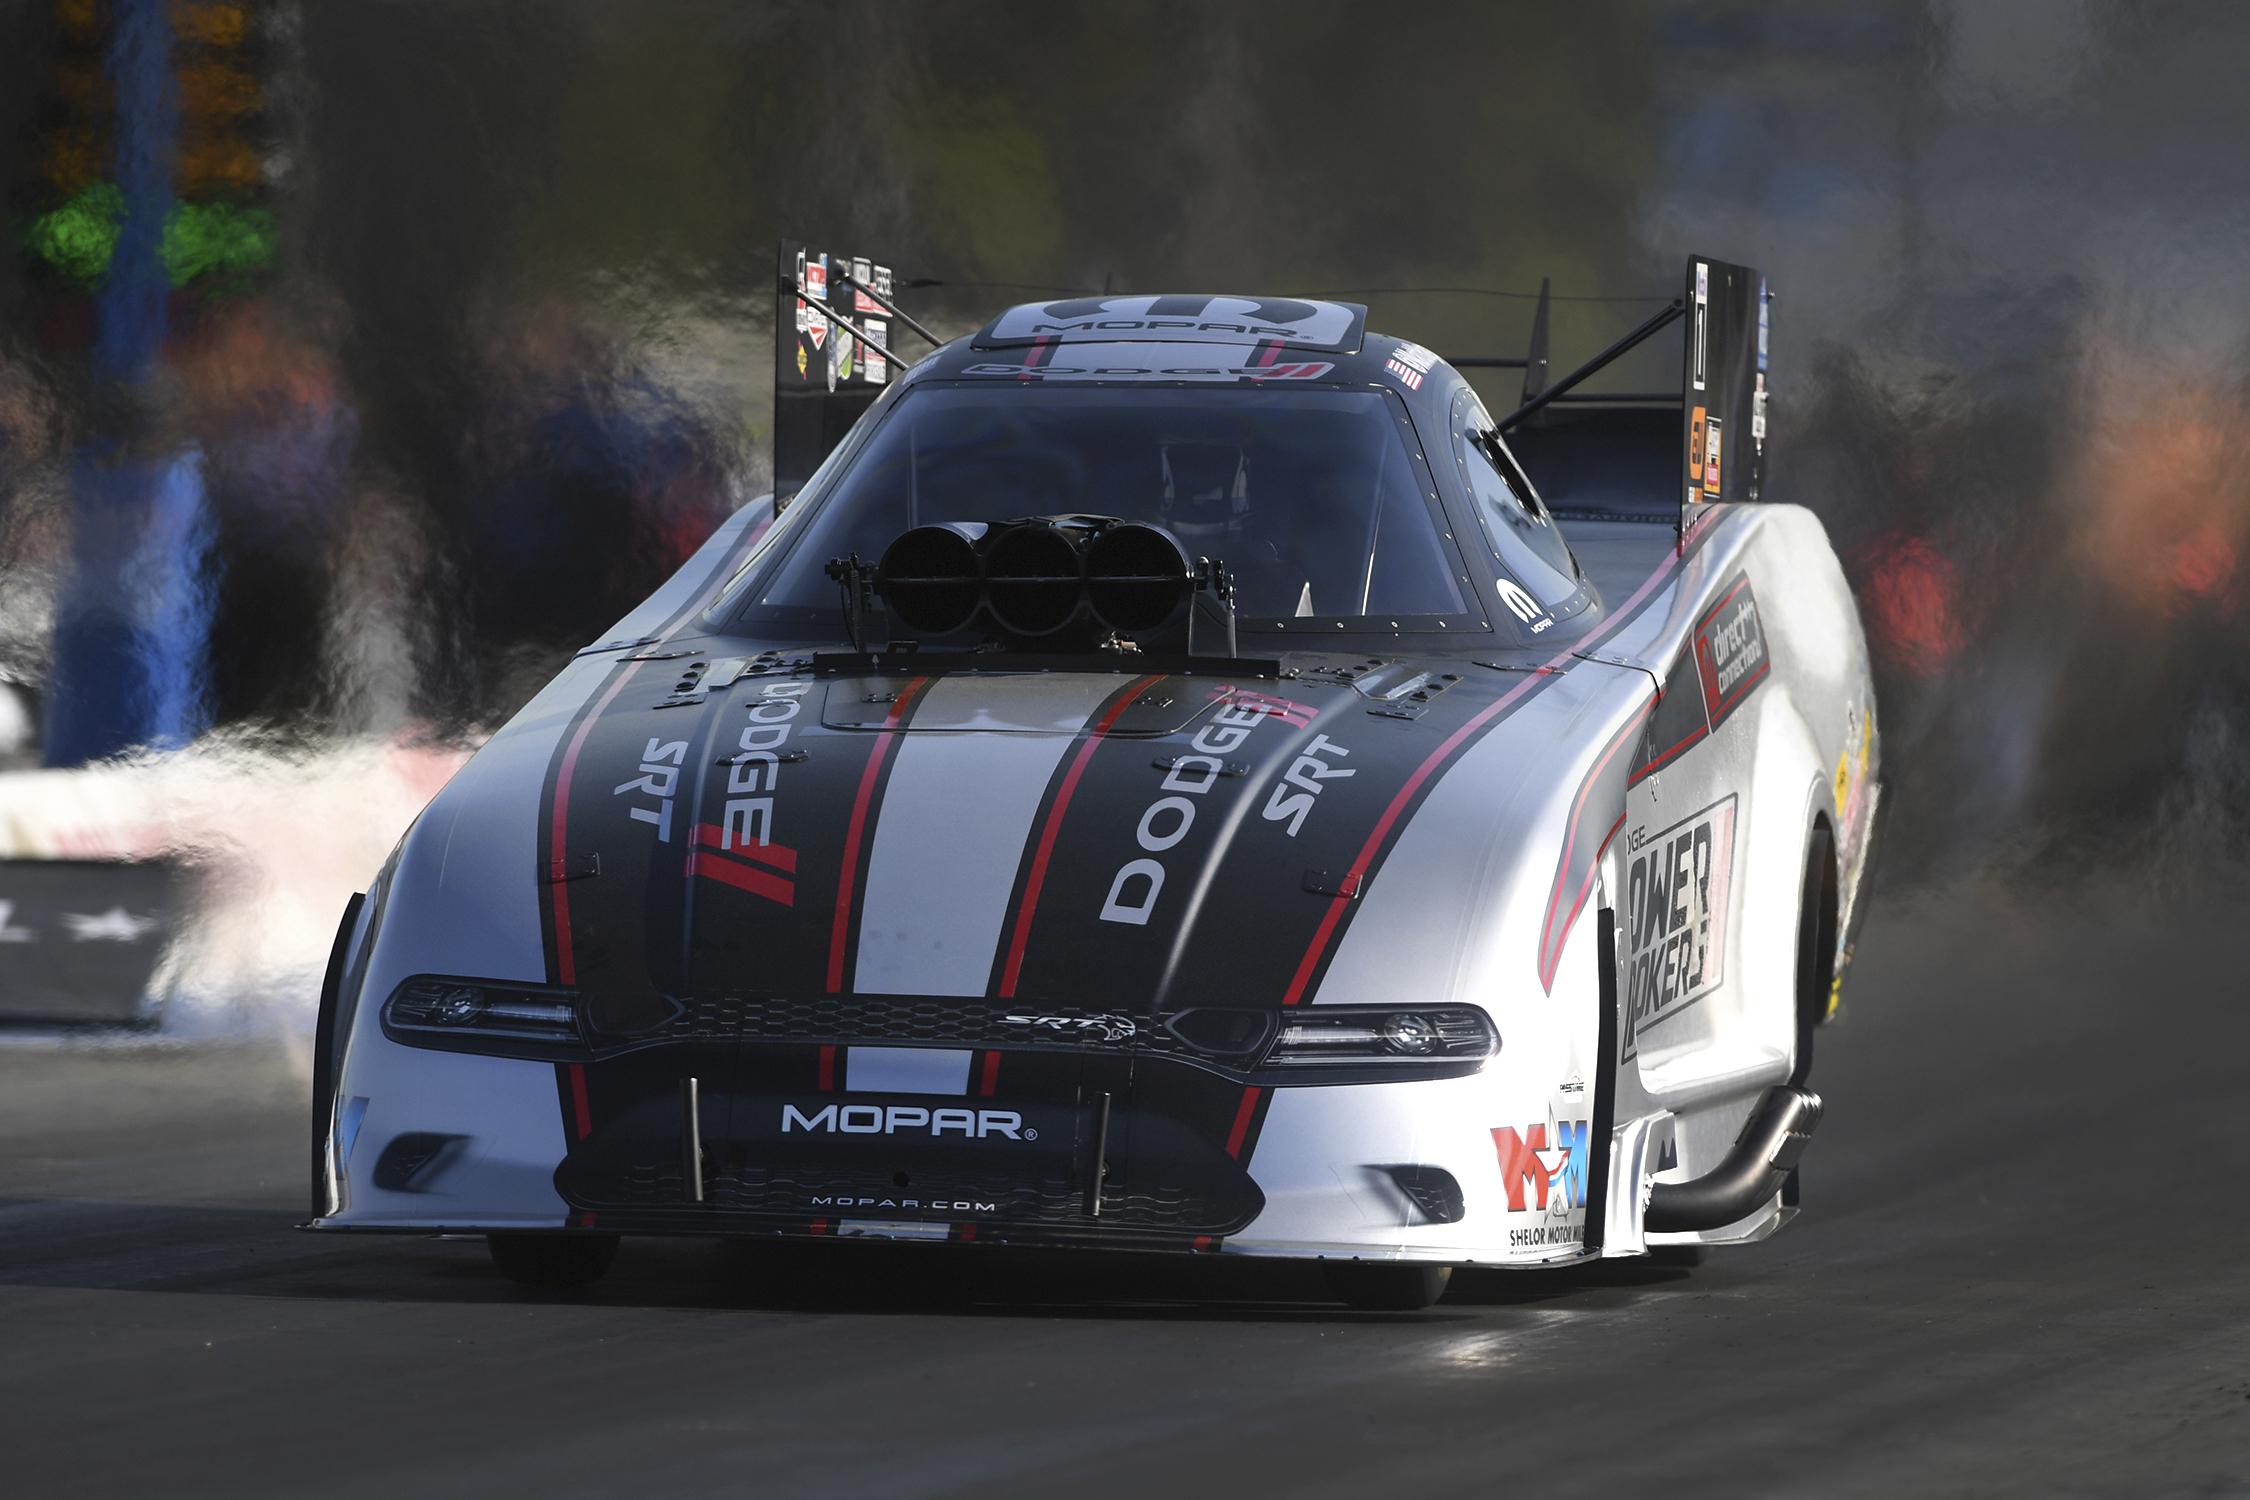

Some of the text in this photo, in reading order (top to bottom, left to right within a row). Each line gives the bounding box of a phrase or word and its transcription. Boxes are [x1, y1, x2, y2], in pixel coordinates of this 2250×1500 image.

[1031, 320, 1300, 338] MOPAR
[1714, 602, 1757, 667] direct
[614, 737, 689, 843] SRT
[721, 682, 814, 850] DODGE
[1261, 733, 1356, 838] SRT
[1099, 702, 1273, 925] DODGE
[1629, 820, 1712, 954] OWER
[996, 1015, 1106, 1030] SRT
[811, 1196, 995, 1212] MOPAR.COM
[1510, 1228, 1546, 1247] SHELOR
[1547, 1225, 1572, 1244] MOTOR
